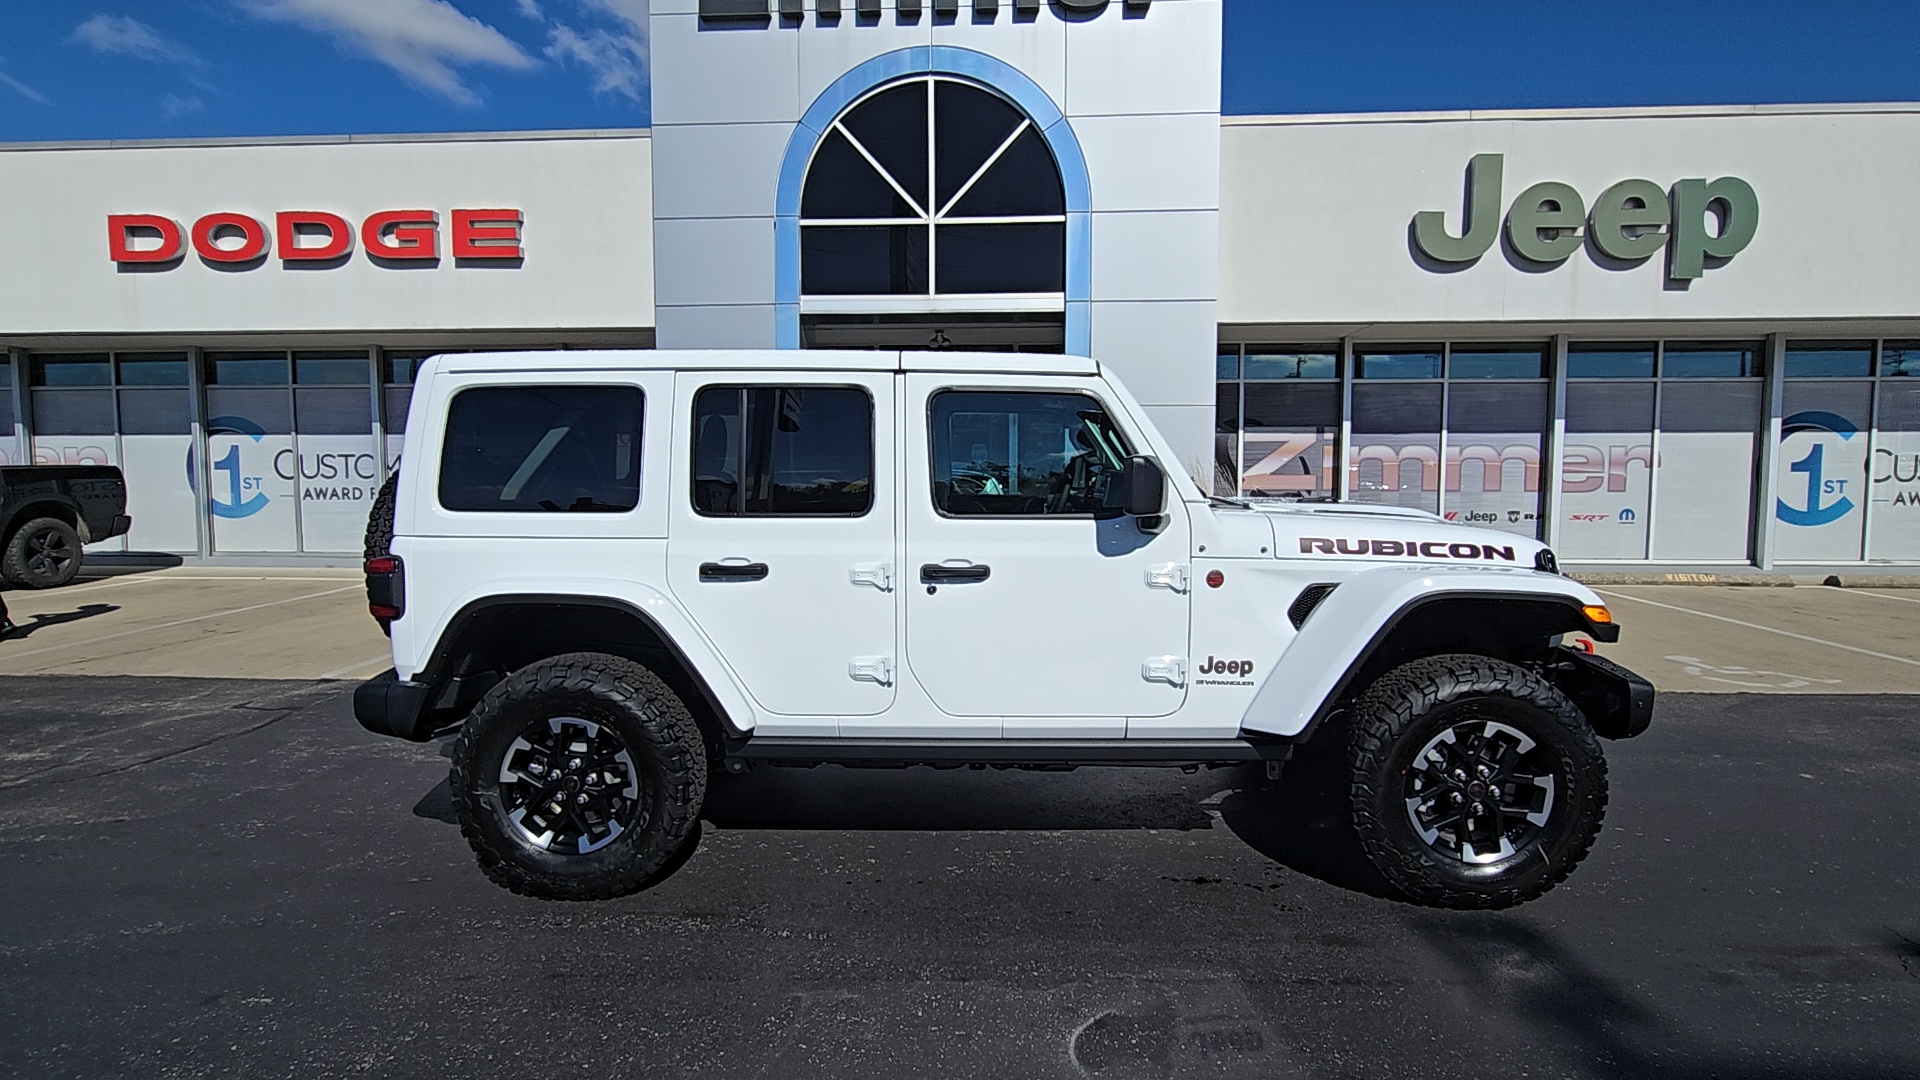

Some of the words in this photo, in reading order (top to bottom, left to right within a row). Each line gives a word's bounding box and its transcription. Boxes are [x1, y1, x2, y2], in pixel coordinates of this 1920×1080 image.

[1411, 153, 1759, 280] Jeep
[107, 208, 523, 263] DODGE
[1241, 430, 1661, 493] Zimmer
[303, 487, 363, 500] AWARD
[1464, 510, 1498, 524] Jeep
[1569, 514, 1610, 523] SRT
[1299, 537, 1516, 562] RUBICON
[1198, 655, 1253, 678] Jeep
